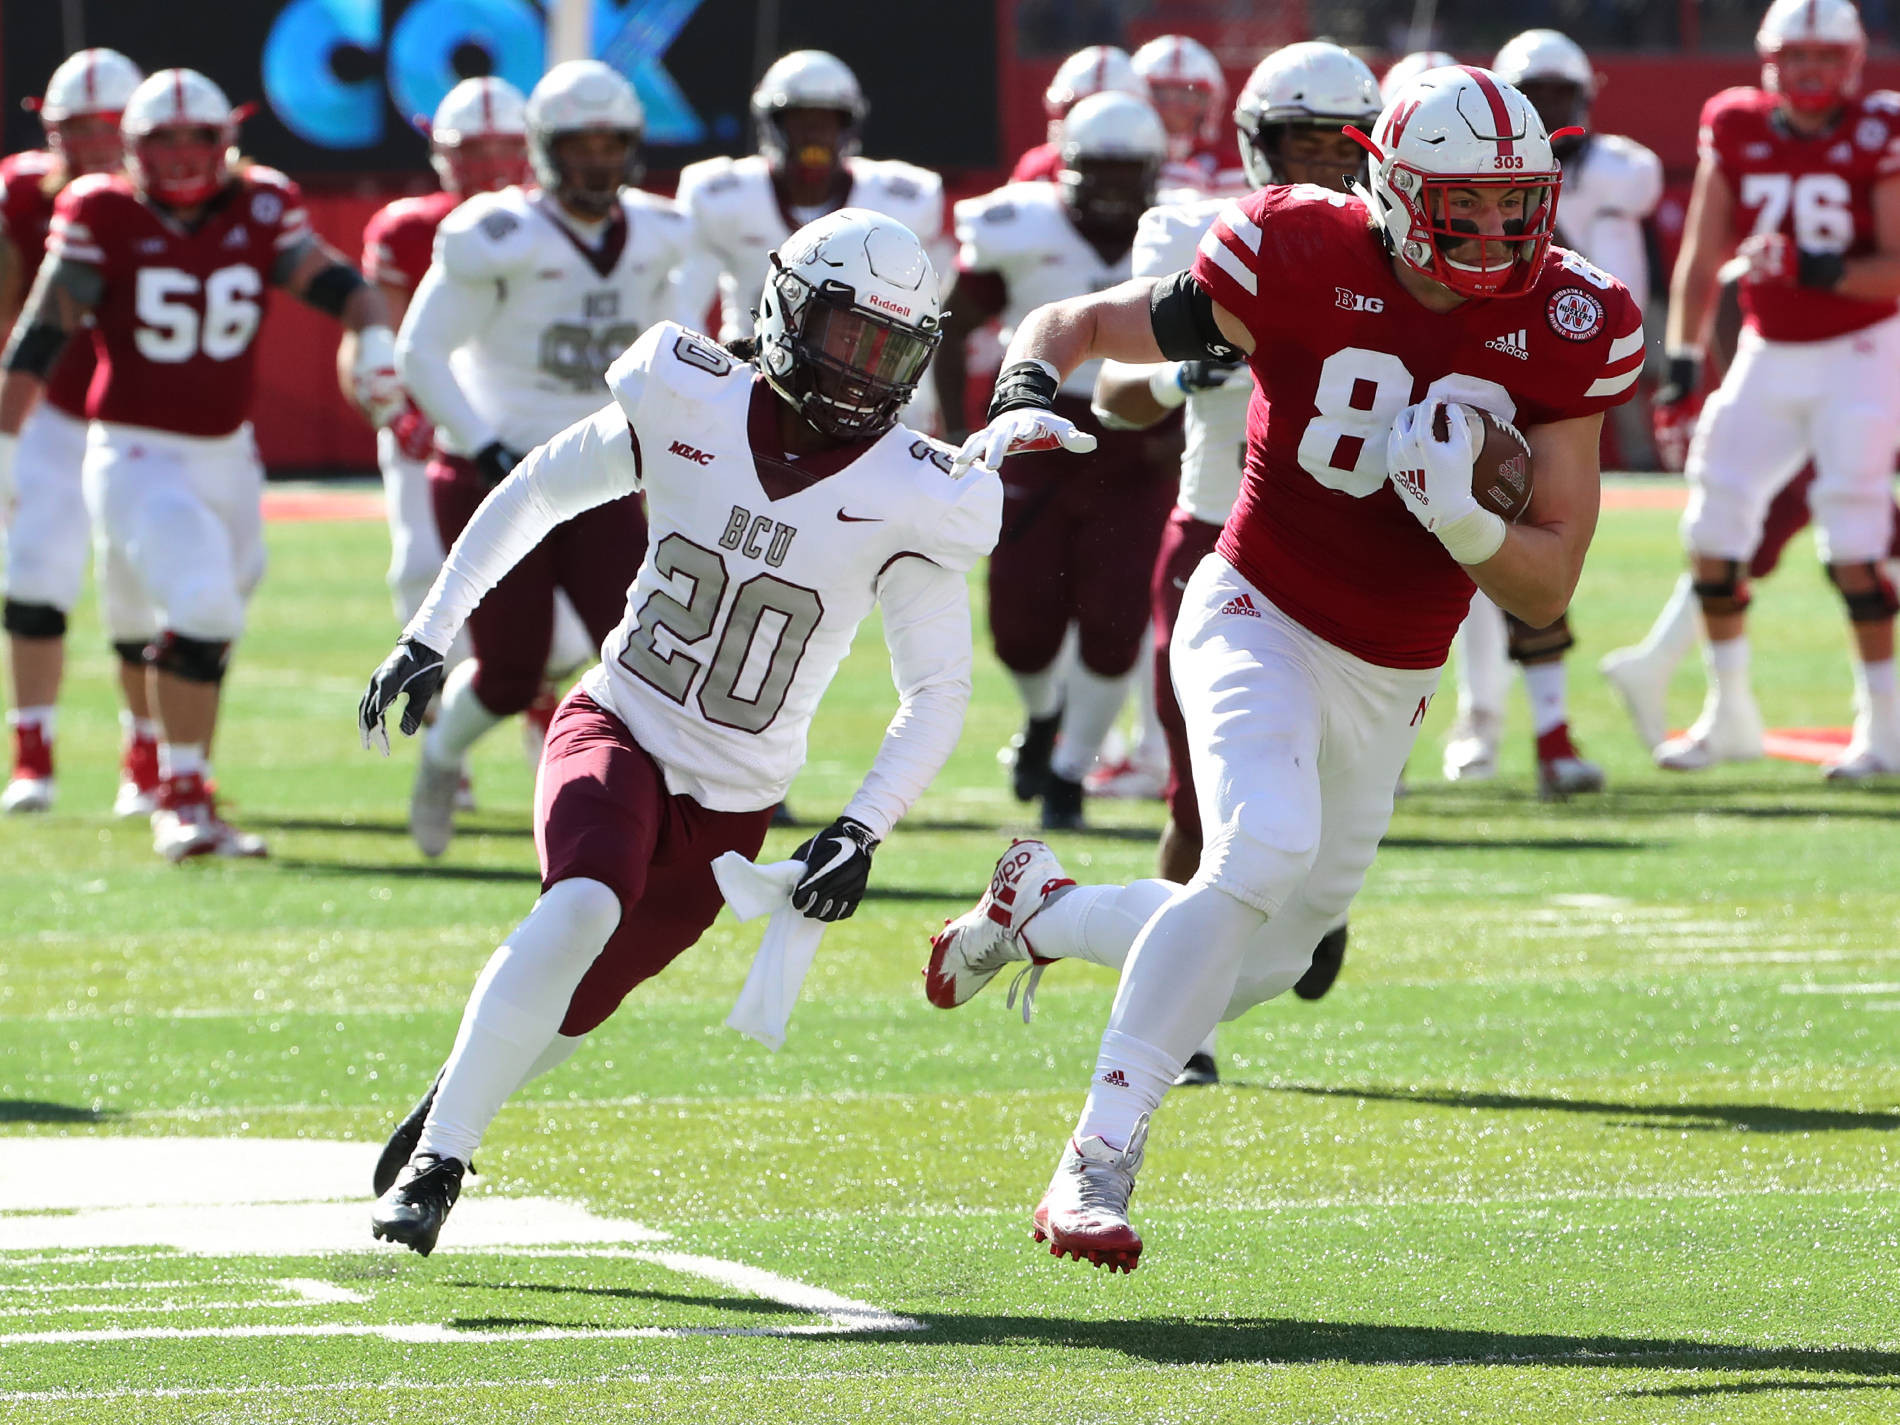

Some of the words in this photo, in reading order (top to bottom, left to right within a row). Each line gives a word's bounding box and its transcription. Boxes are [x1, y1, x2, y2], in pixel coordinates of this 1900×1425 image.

[1381, 99, 1422, 149] N
[1494, 157, 1523, 169] 303
[1740, 173, 1855, 255] 76
[133, 263, 263, 363] 56
[869, 295, 911, 317] Riddell
[1559, 303, 1593, 323] HUSKERS
[1570, 325, 1600, 340] TRADITION
[1485, 340, 1529, 361] adidas
[668, 441, 715, 466] MEAC
[1394, 473, 1430, 506] adidas
[718, 504, 797, 568] BCU
[1221, 605, 1261, 619] adidas
[618, 532, 824, 735] 20
